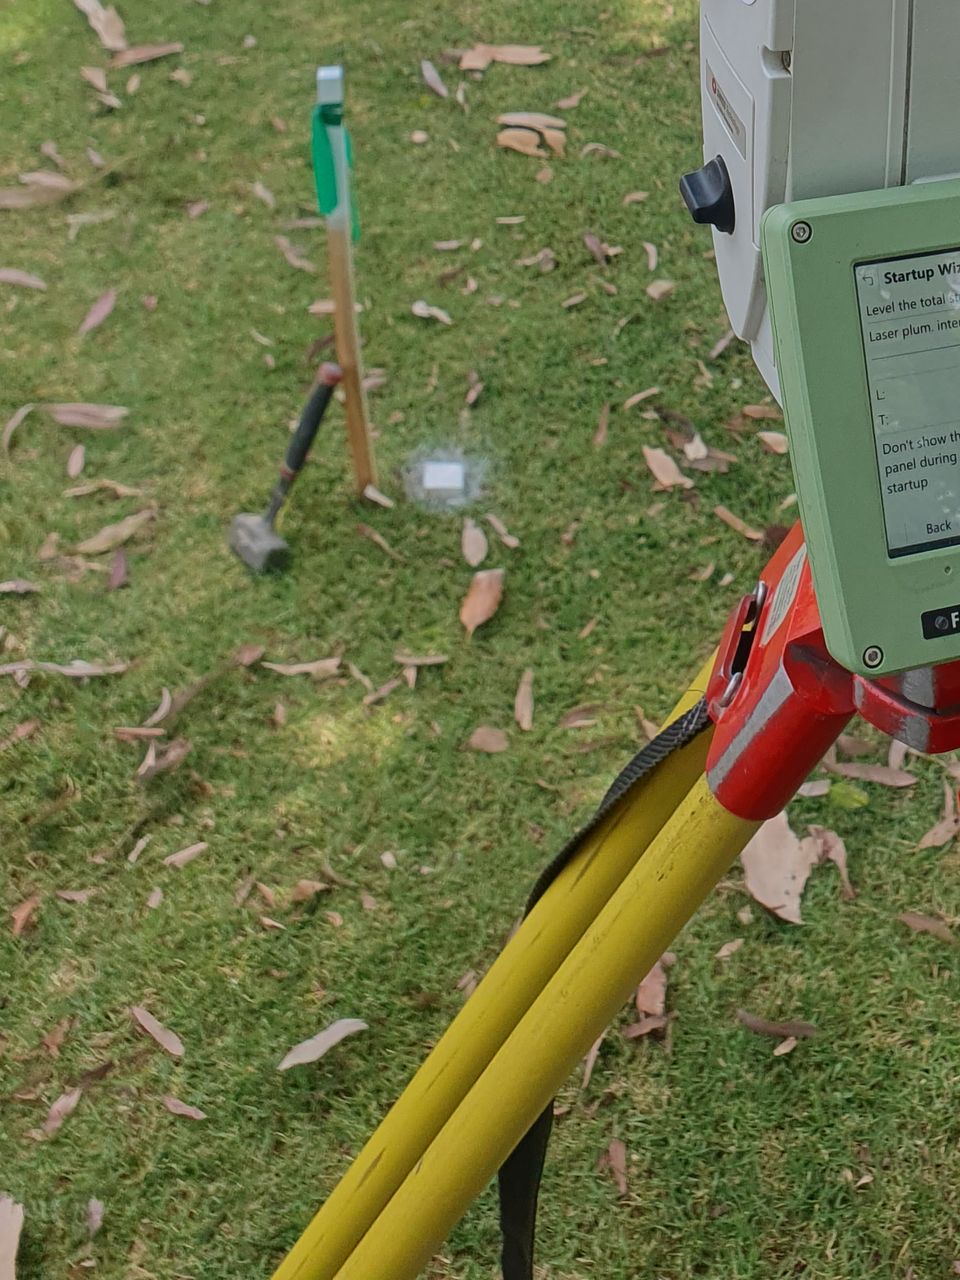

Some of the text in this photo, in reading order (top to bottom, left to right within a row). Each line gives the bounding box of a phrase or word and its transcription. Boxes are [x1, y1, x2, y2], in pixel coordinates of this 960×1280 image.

[884, 268, 935, 285] Startup
[866, 301, 895, 317] Level
[898, 298, 917, 311] the
[920, 293, 946, 308] total
[869, 327, 899, 342] Laser
[902, 322, 934, 340] plum.
[876, 390, 885, 400] L:
[878, 414, 889, 425] T:
[882, 439, 914, 455] Don't
[917, 435, 947, 449] show
[885, 452, 958, 477] panel during
[887, 478, 929, 494] startup
[926, 520, 952, 534] Back
